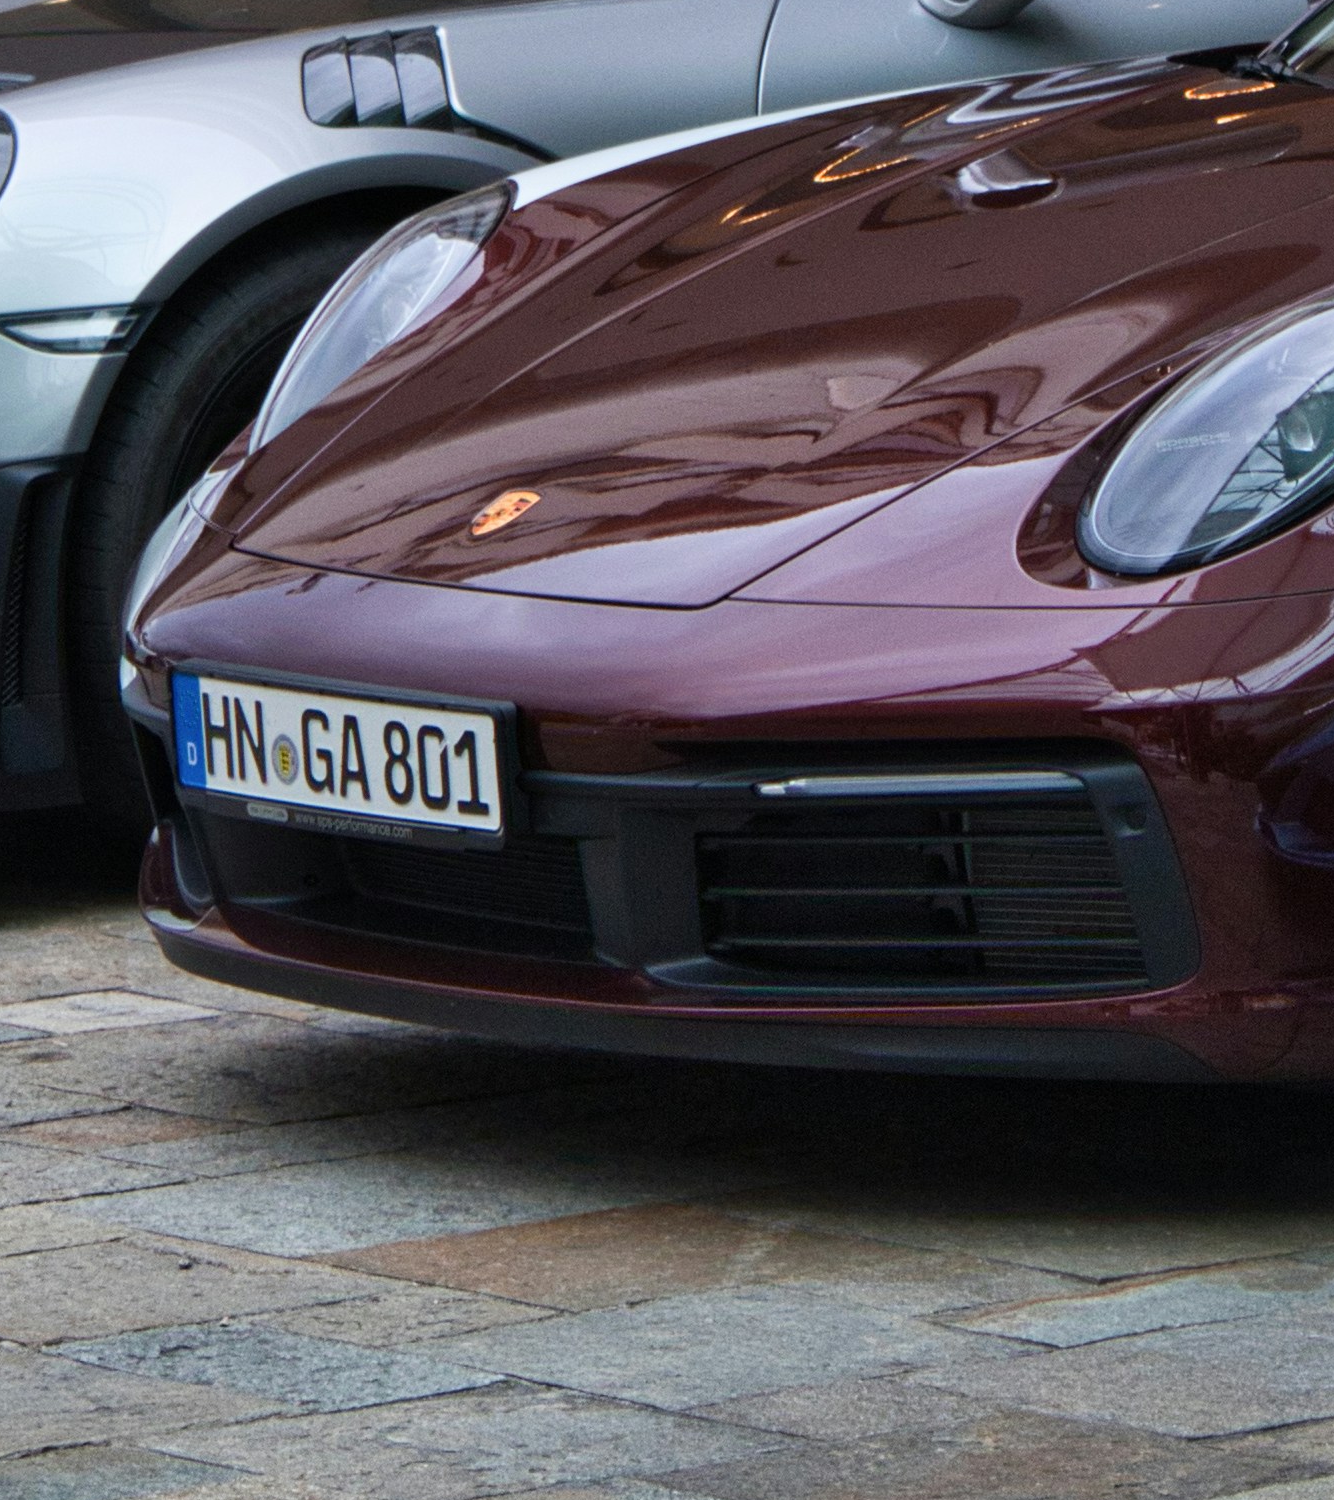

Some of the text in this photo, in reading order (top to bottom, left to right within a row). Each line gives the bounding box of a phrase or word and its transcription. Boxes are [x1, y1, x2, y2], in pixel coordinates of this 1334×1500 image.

[187, 742, 198, 766] D
[202, 692, 490, 816] HN GA 801
